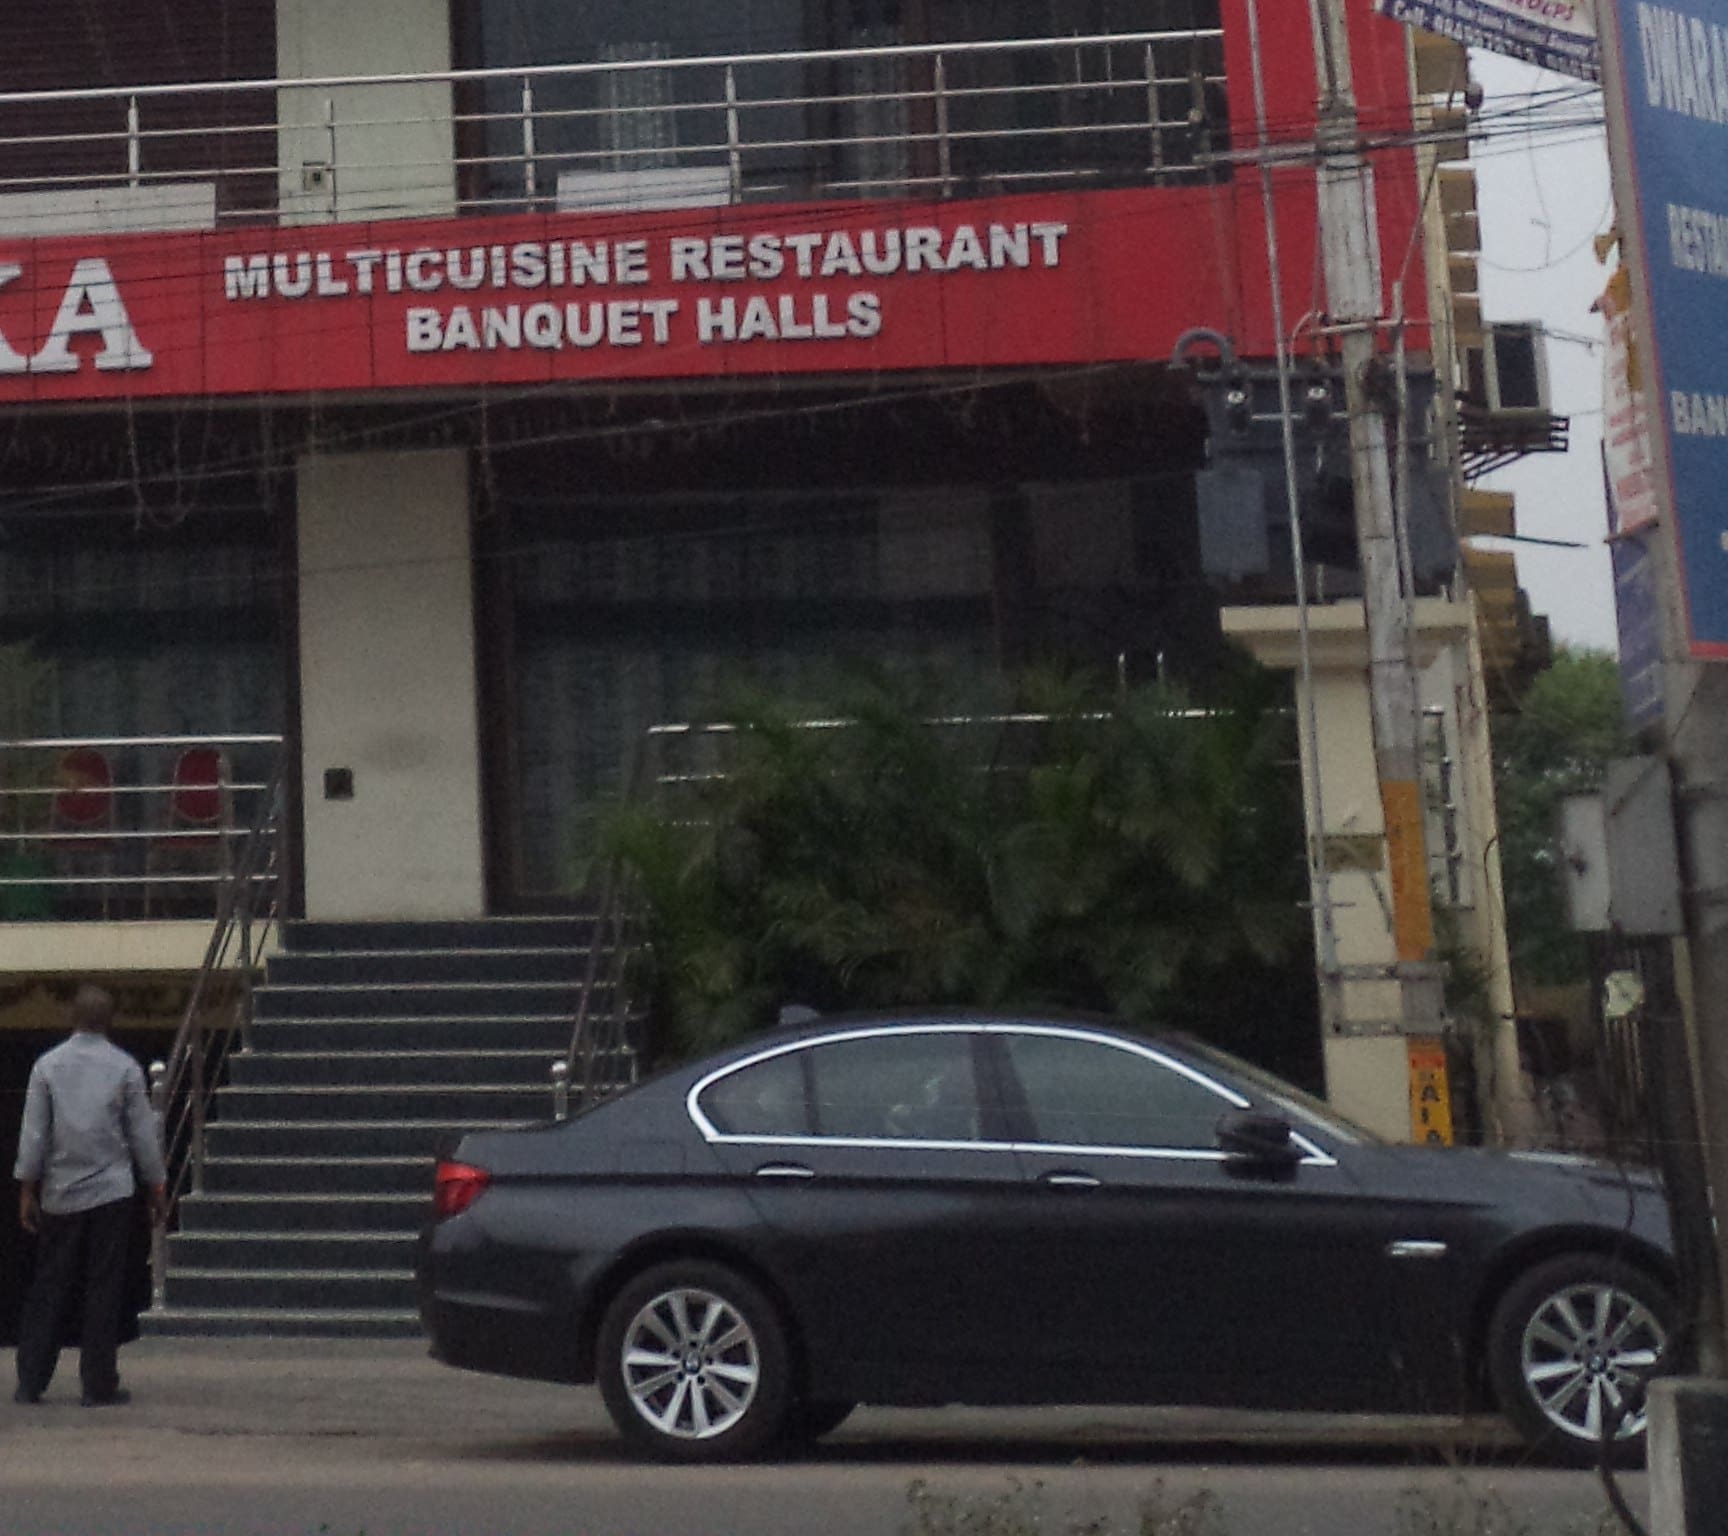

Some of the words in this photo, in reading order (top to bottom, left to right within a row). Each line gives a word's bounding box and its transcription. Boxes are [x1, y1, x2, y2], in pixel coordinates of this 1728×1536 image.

[223, 238, 651, 301] MULTICUISINE
[671, 221, 1070, 283] RESTAURANT
[406, 297, 679, 352] BANQUET
[696, 290, 884, 344] HALLS
